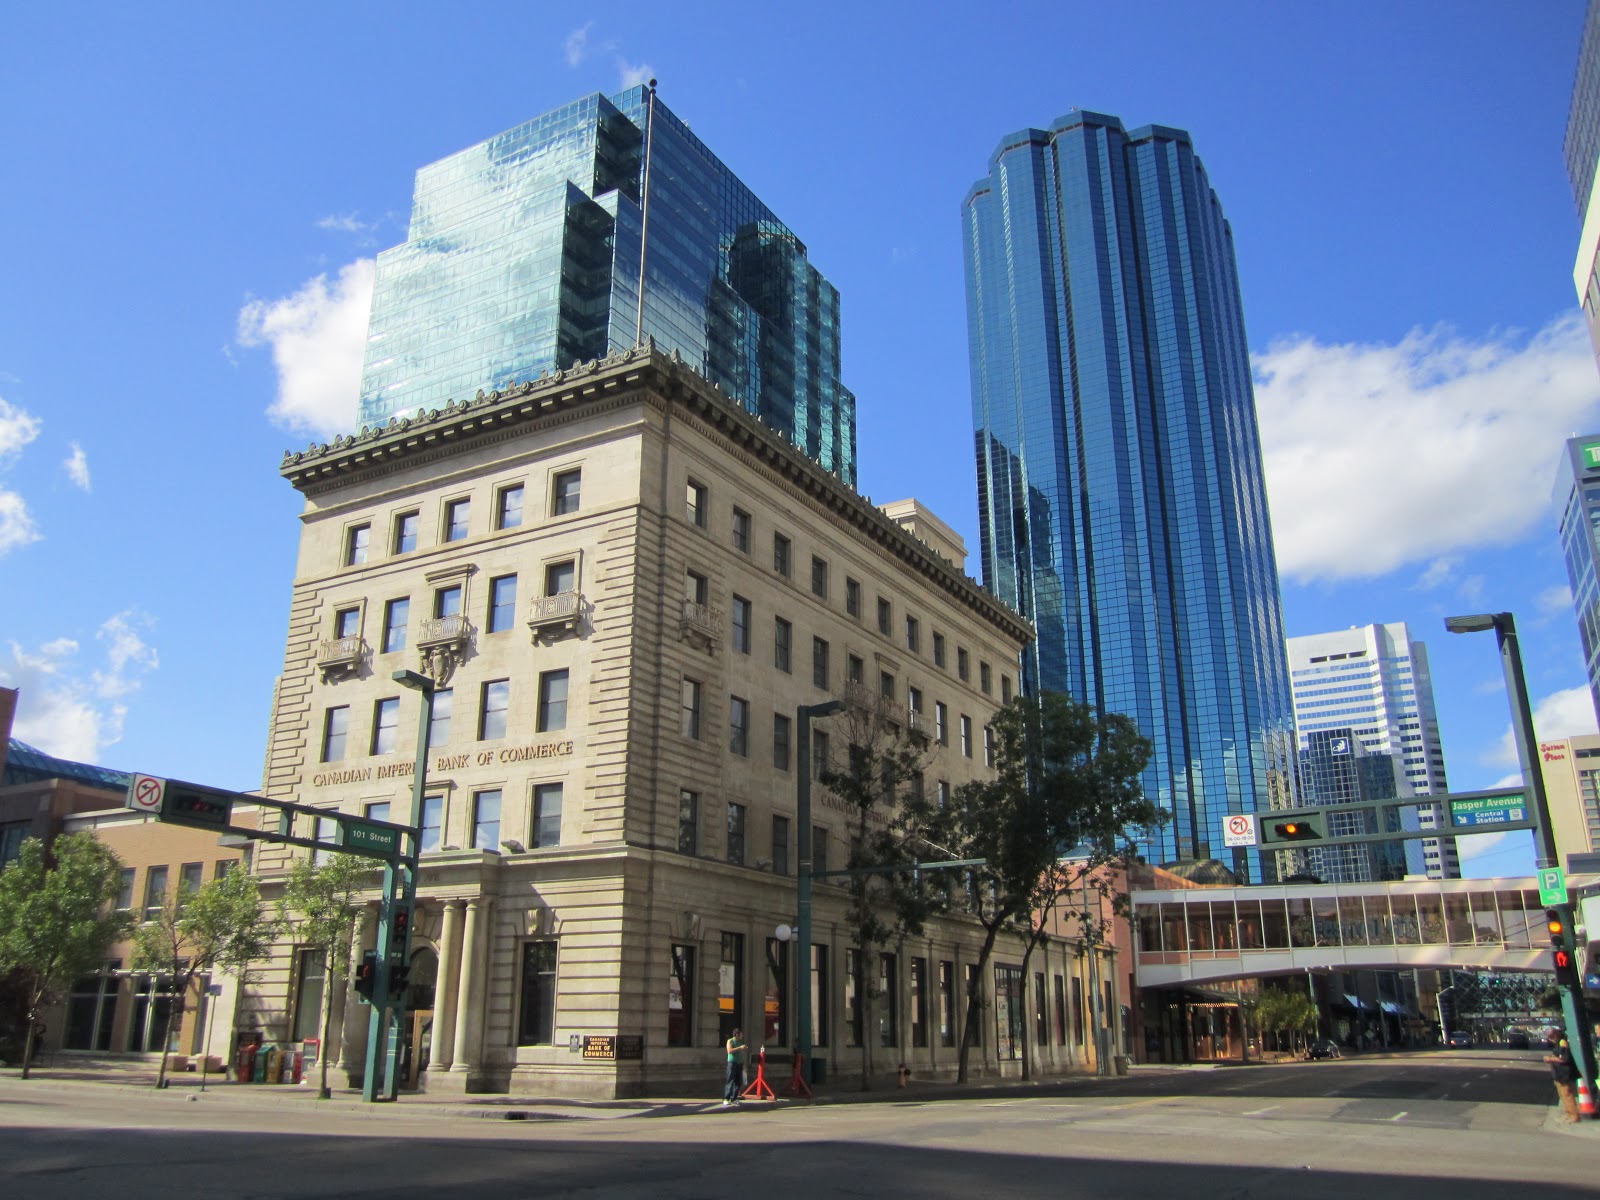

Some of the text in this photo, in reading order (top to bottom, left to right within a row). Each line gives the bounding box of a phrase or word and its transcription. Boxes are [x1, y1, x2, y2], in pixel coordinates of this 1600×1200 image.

[1585, 446, 1600, 462] T
[313, 767, 372, 787] CANADIAN
[437, 754, 471, 772] BANK
[477, 751, 494, 766] OF
[500, 741, 574, 764] COMMERCE
[1453, 797, 1523, 811] Jasper Avenue
[1475, 810, 1504, 818] Central
[1476, 816, 1505, 824] Station
[352, 830, 392, 843] 101 Street
[1545, 872, 1558, 889] P
